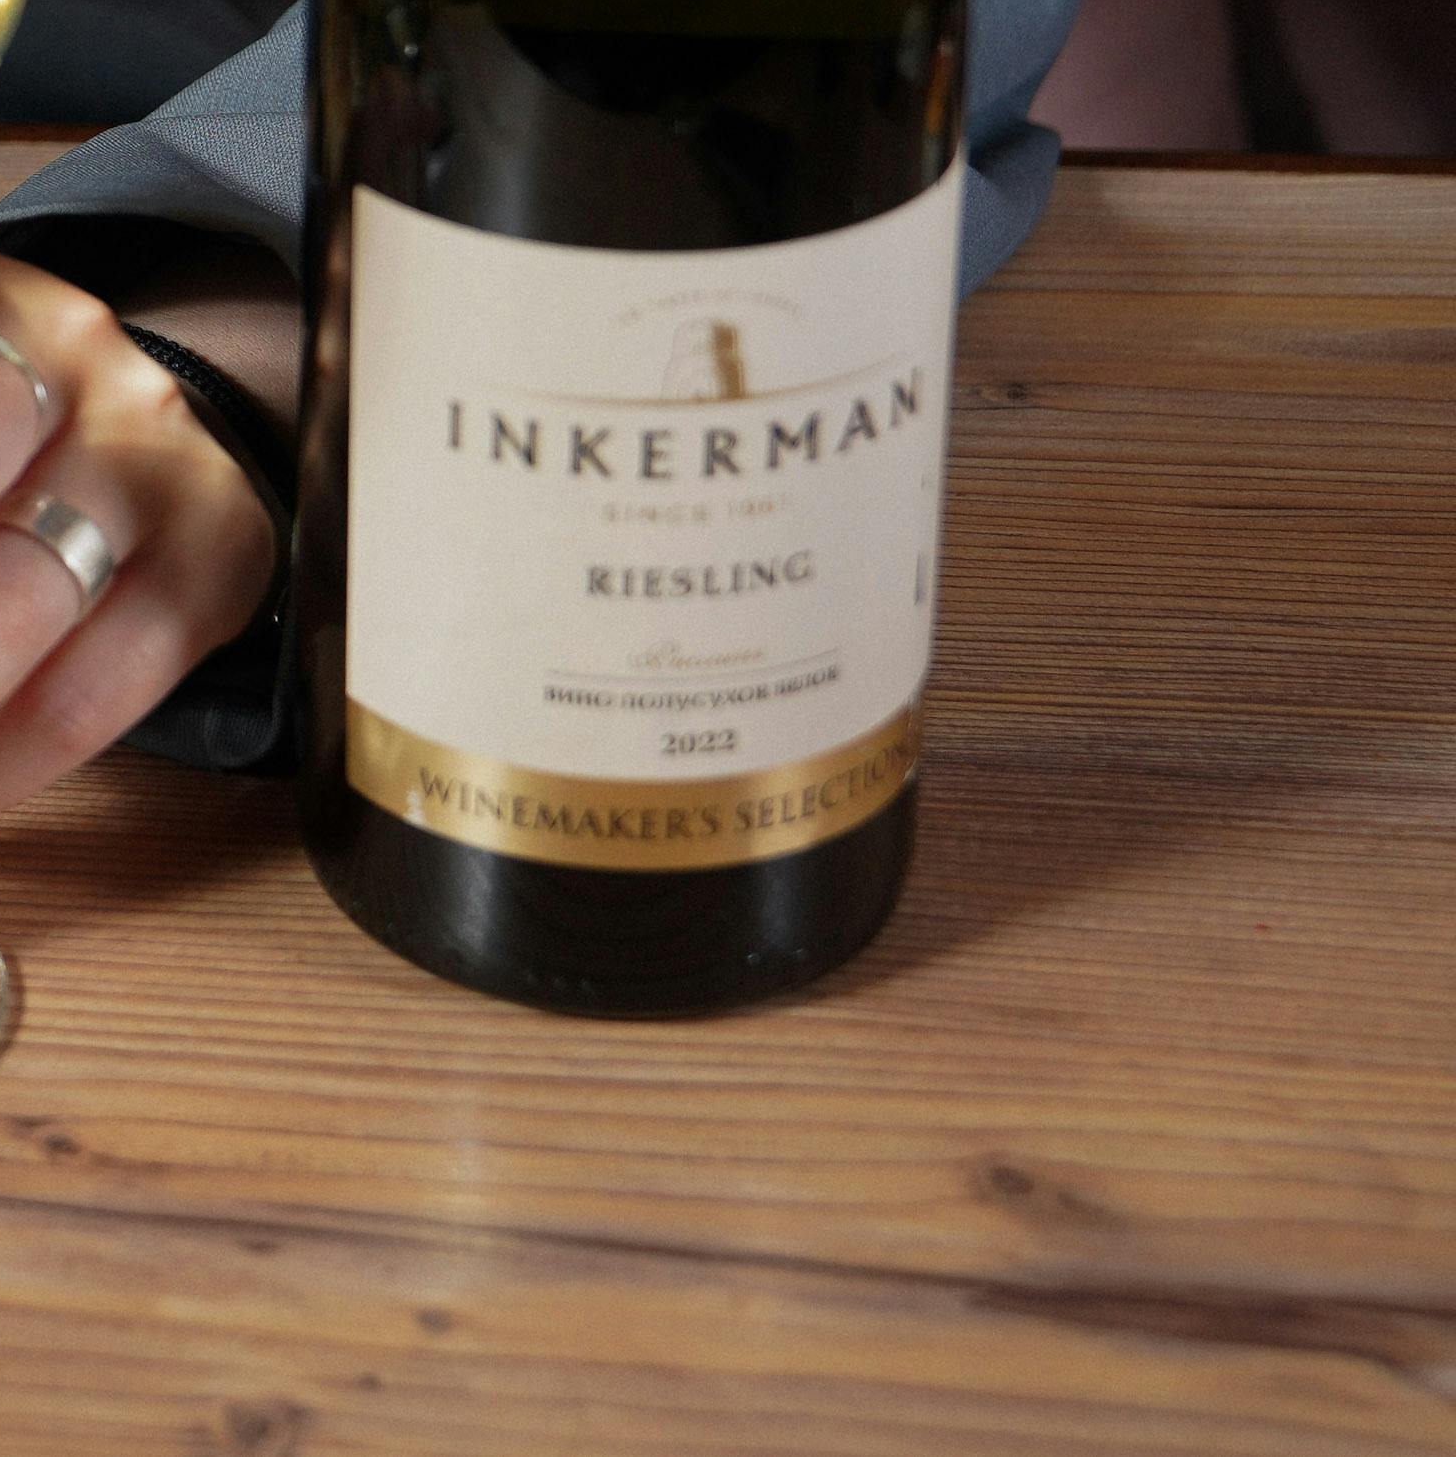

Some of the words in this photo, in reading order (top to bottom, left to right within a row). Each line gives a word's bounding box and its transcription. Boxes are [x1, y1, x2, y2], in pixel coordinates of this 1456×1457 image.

[447, 366, 922, 480] INKERMAN
[586, 550, 814, 597] RIESLING
[662, 729, 736, 755] 2022
[419, 766, 721, 840] WINEMAKER'S
